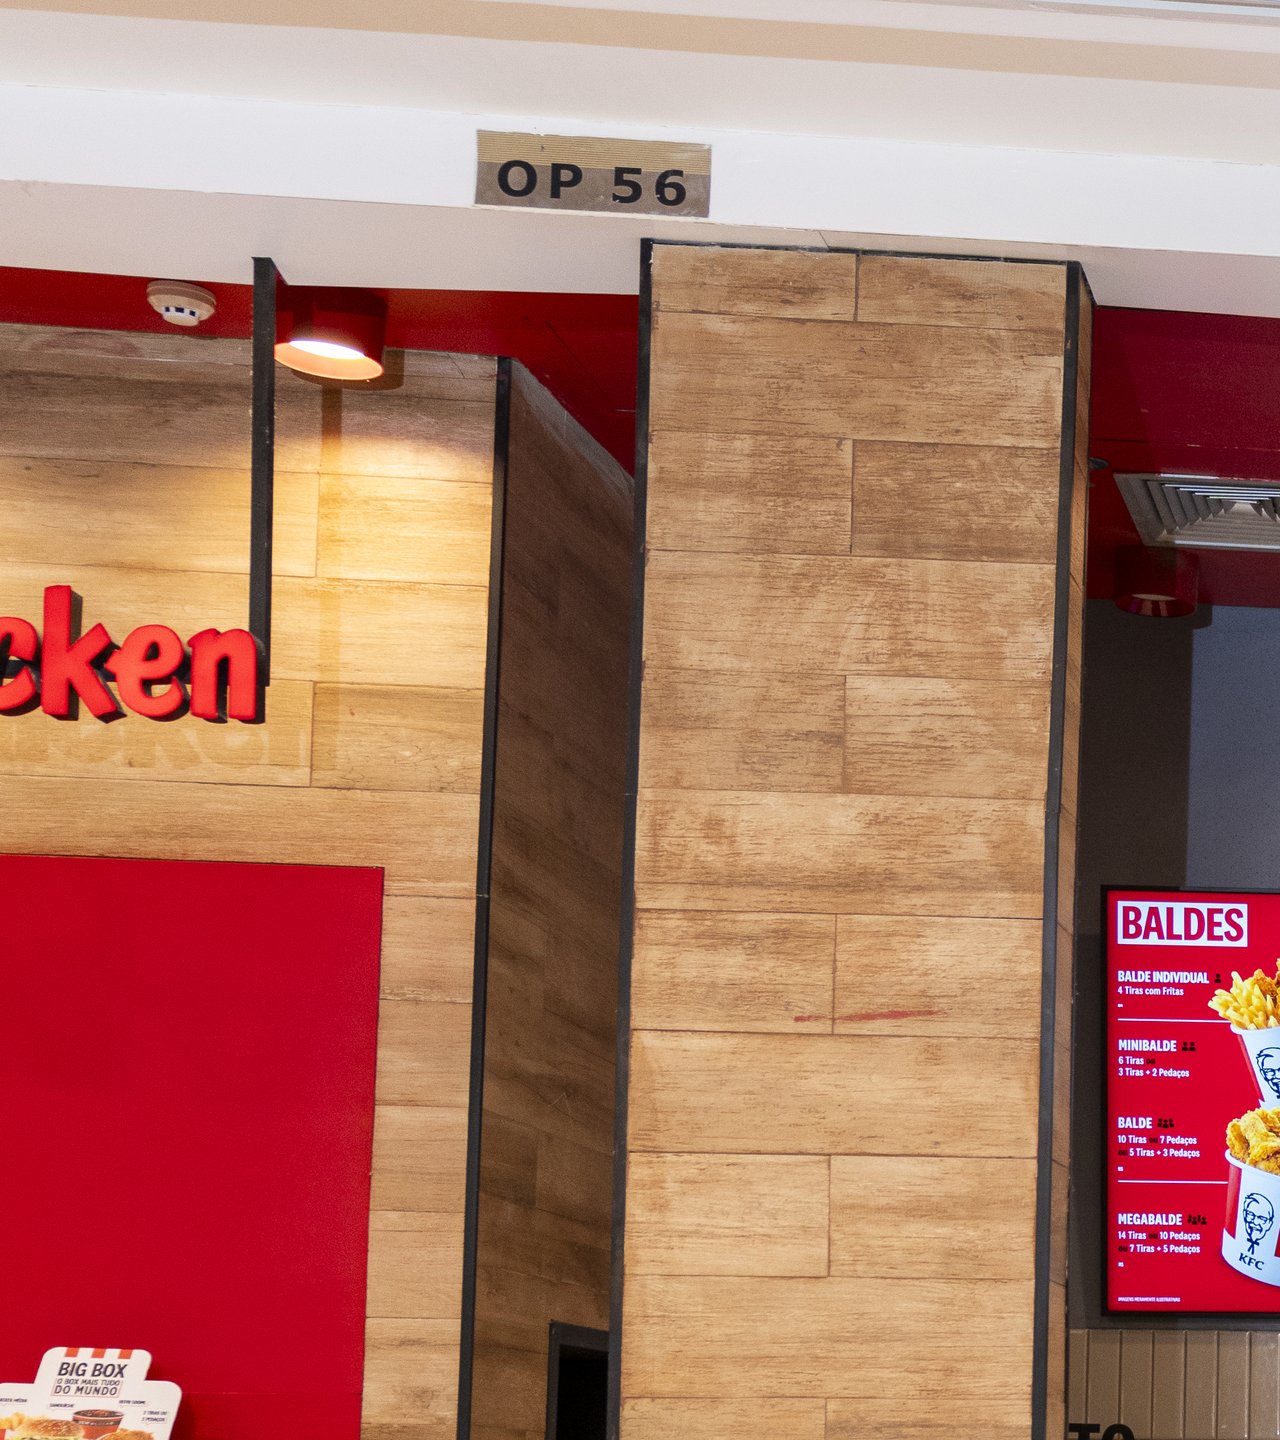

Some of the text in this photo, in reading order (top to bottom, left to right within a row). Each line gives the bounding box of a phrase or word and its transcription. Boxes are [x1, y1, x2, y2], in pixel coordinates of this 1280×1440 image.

[497, 159, 688, 206] OP 56
[0, 585, 258, 721] cken
[1122, 906, 1244, 942] BALDES
[1118, 971, 1209, 984] BALDE INDIVIDUAL
[1118, 986, 1123, 995] 4
[1125, 987, 1143, 995] Tiras
[1163, 987, 1184, 996] Fritas
[1118, 1040, 1177, 1052] MINIBALDE
[1118, 1117, 1152, 1128] BALDE
[1118, 1214, 1182, 1225] MEGABALDE
[1239, 1253, 1264, 1270] KFC
[58, 1362, 128, 1378] BIG BOX
[54, 1386, 117, 1395] DO MUNDO
